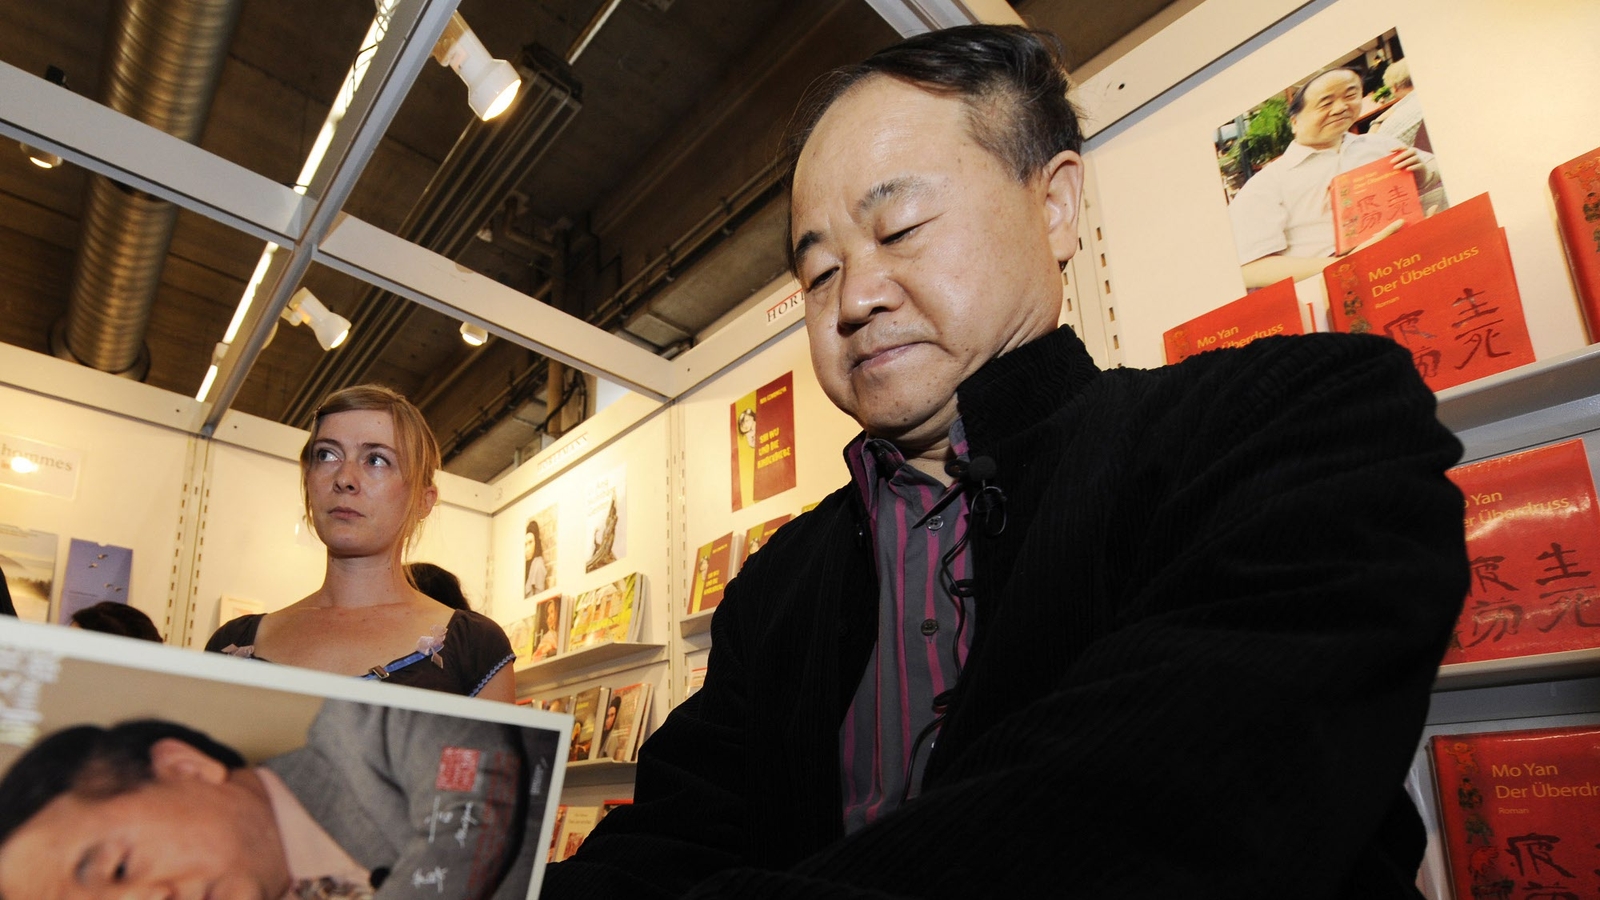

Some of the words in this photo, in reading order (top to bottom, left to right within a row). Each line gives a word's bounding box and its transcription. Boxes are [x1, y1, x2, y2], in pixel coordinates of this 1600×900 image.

[1368, 266, 1393, 282] Mo
[1393, 253, 1421, 270] Yan
[1371, 280, 1398, 298] Der
[1400, 246, 1479, 285] Überdruss
[1197, 335, 1217, 349] Mo
[1216, 326, 1239, 340] Yan
[1470, 491, 1503, 506] Yan
[1478, 497, 1570, 524] Überdruss
[1492, 764, 1522, 777] Mo
[1523, 763, 1559, 776] Yan
[1495, 785, 1528, 799] Der
[1532, 781, 1600, 798] Überdr
[1498, 807, 1530, 815] Roman
